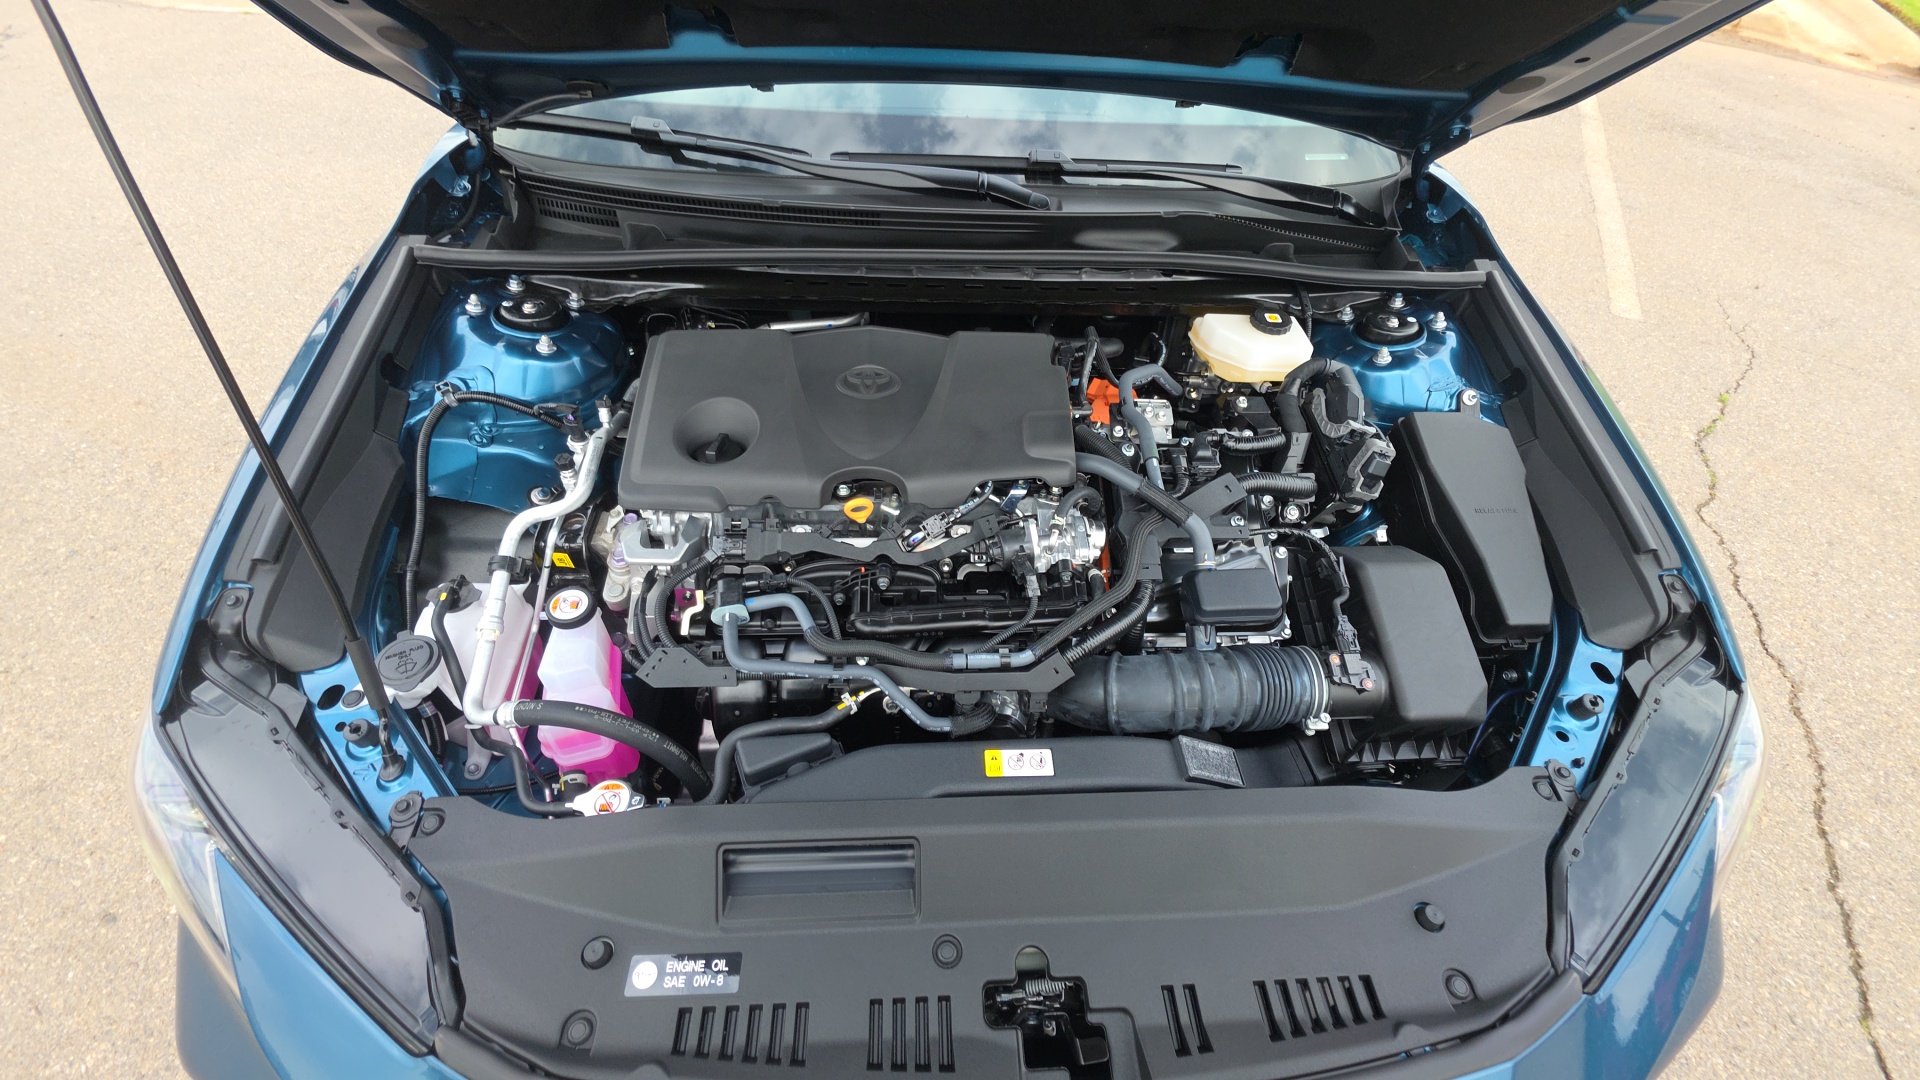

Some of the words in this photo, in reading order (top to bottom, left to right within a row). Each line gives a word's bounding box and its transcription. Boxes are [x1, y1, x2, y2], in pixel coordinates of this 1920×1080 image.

[385, 650, 407, 660] WASHER
[666, 960, 706, 973] ENGINE
[711, 959, 729, 971] OIL
[663, 976, 687, 988] SAE
[693, 974, 724, 987] 0W-8
